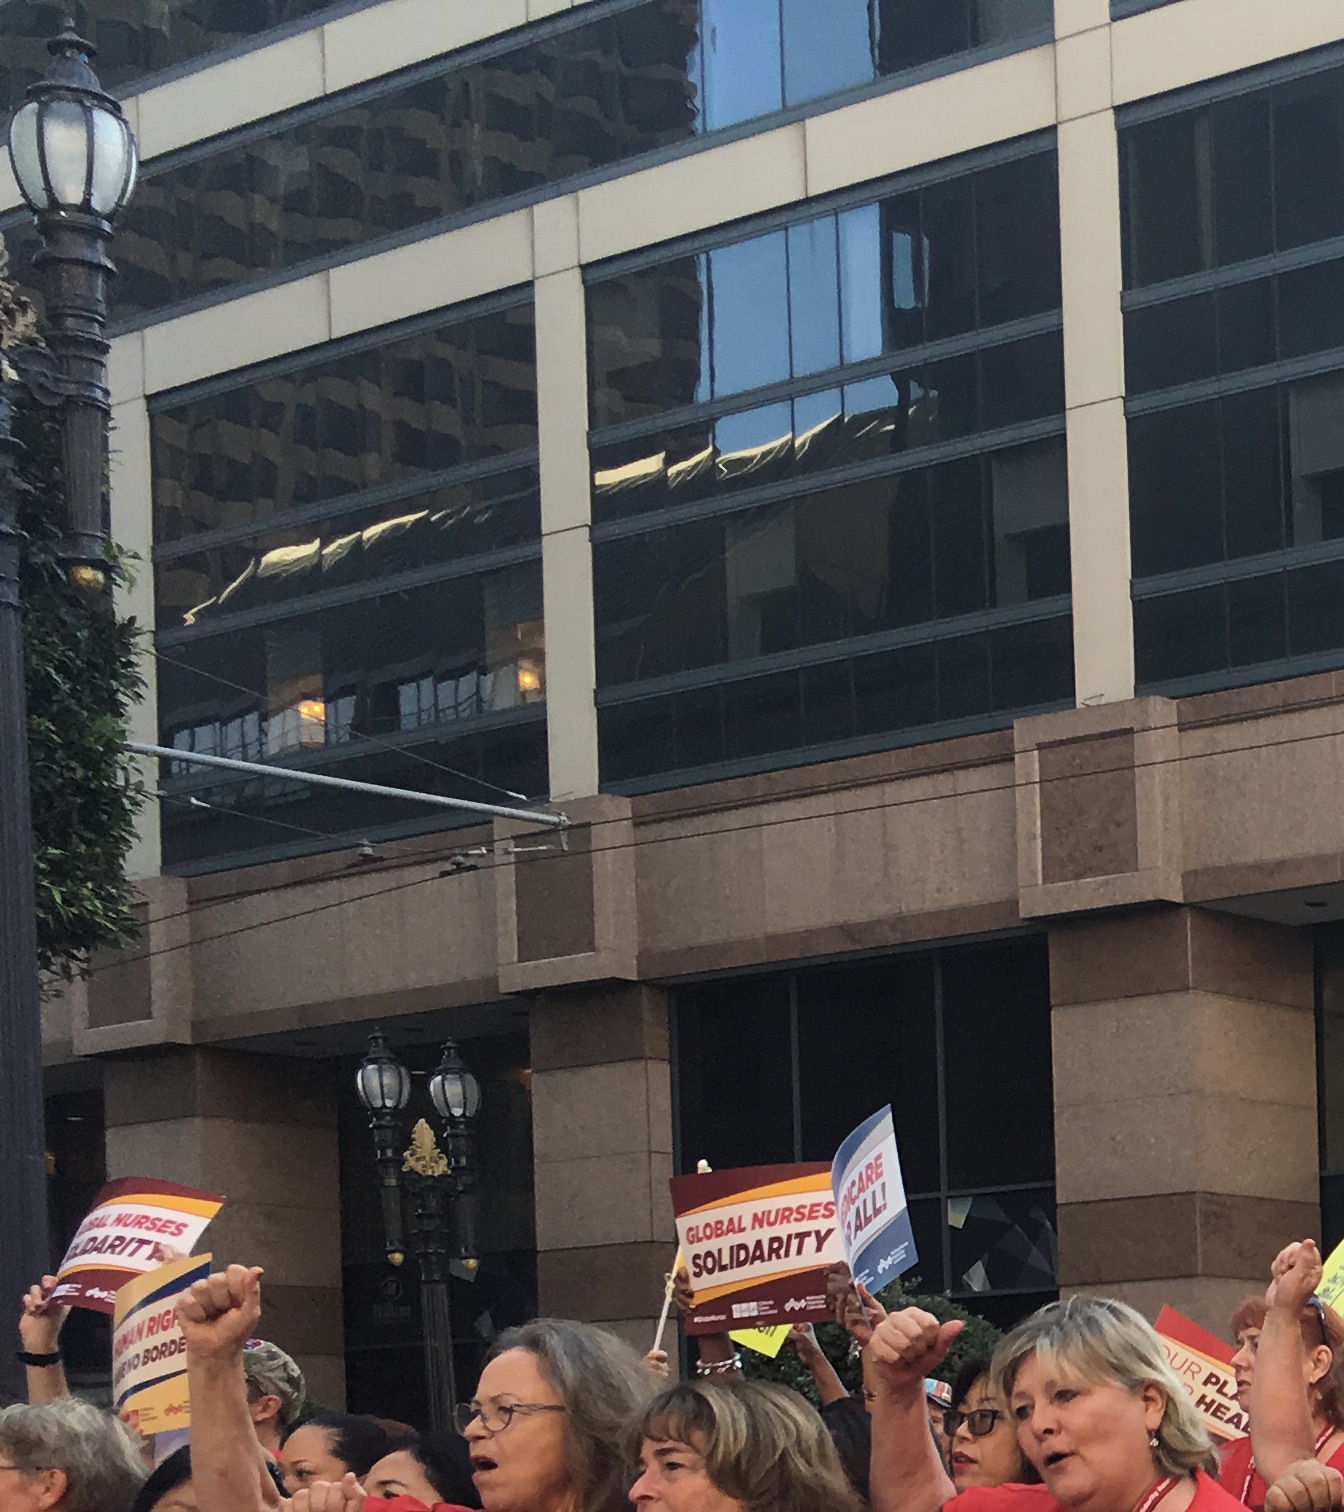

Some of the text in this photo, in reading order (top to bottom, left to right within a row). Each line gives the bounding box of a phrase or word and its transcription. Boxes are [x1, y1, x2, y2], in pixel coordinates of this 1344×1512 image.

[112, 1213, 190, 1237] NURSES
[686, 1215, 746, 1246] GLOBAL
[751, 1201, 835, 1231] NURSES
[853, 1181, 888, 1239] ALL!
[692, 1227, 837, 1279] SOLIDARITY
[140, 1336, 187, 1366] BORDE
